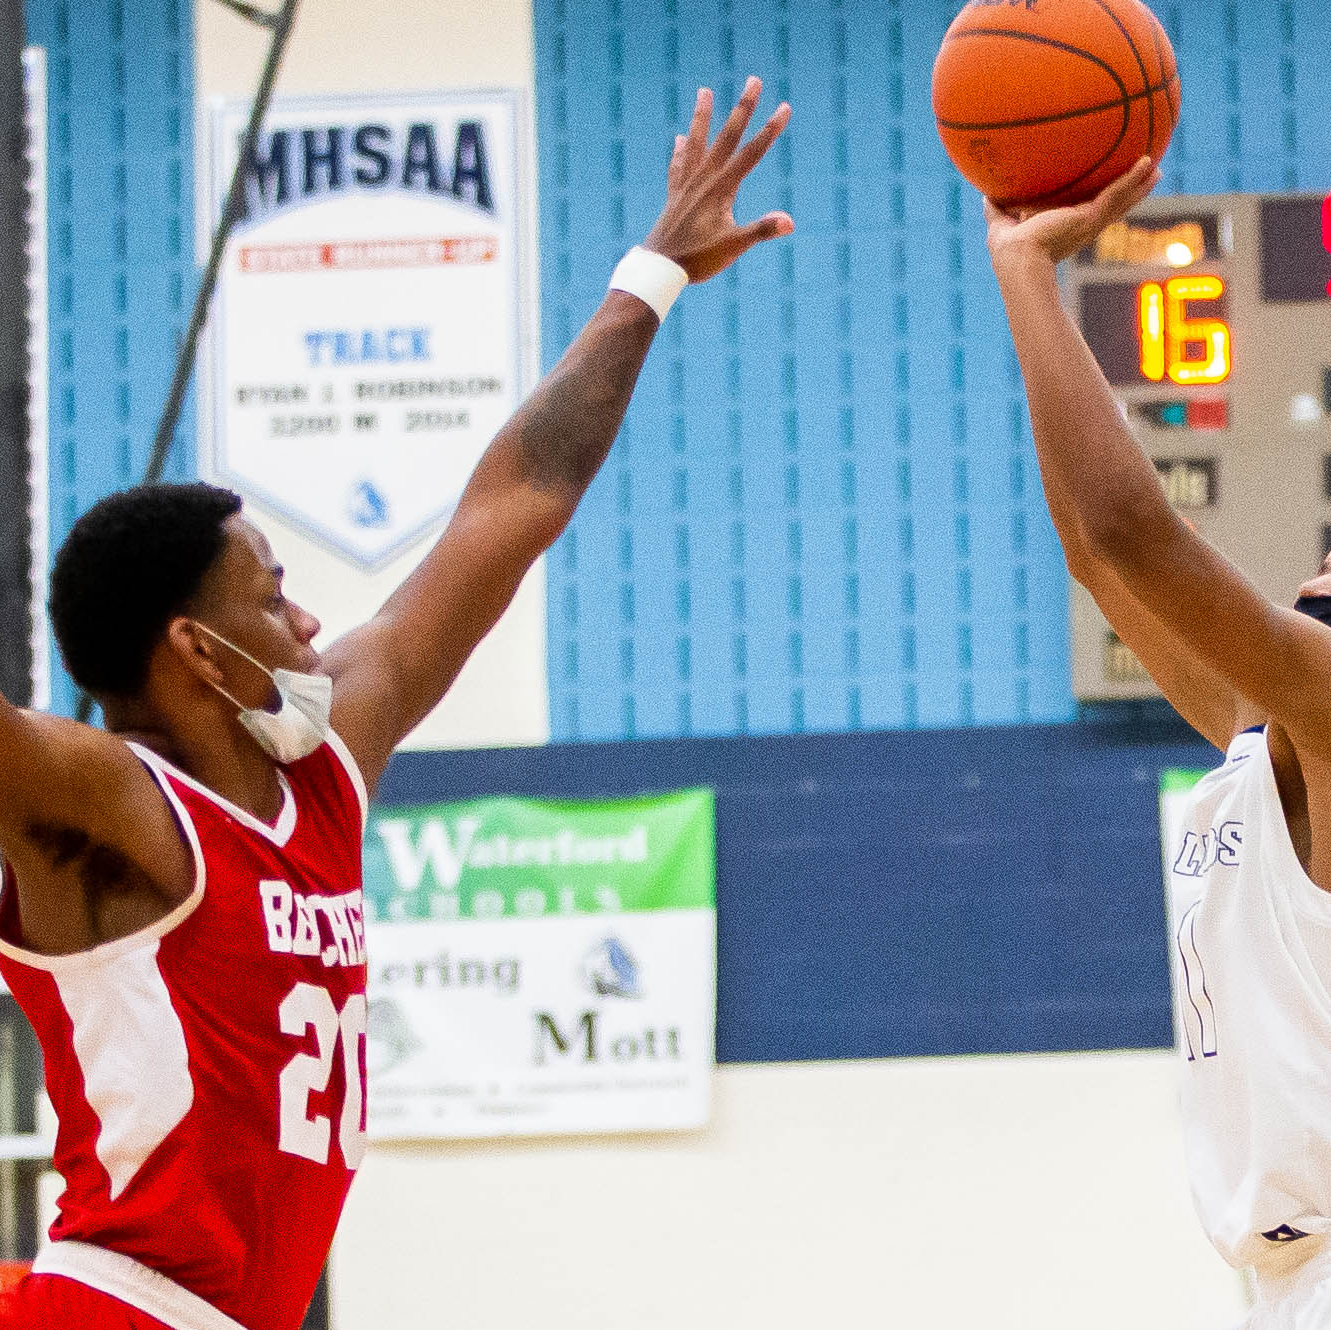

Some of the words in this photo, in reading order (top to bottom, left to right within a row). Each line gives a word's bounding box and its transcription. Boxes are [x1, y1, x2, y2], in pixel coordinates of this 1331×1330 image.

[236, 117, 497, 222] MHSAA
[302, 327, 433, 369] TRACK
[1137, 274, 1232, 386] 16
[380, 950, 522, 995] ering
[277, 980, 367, 1172] 20
